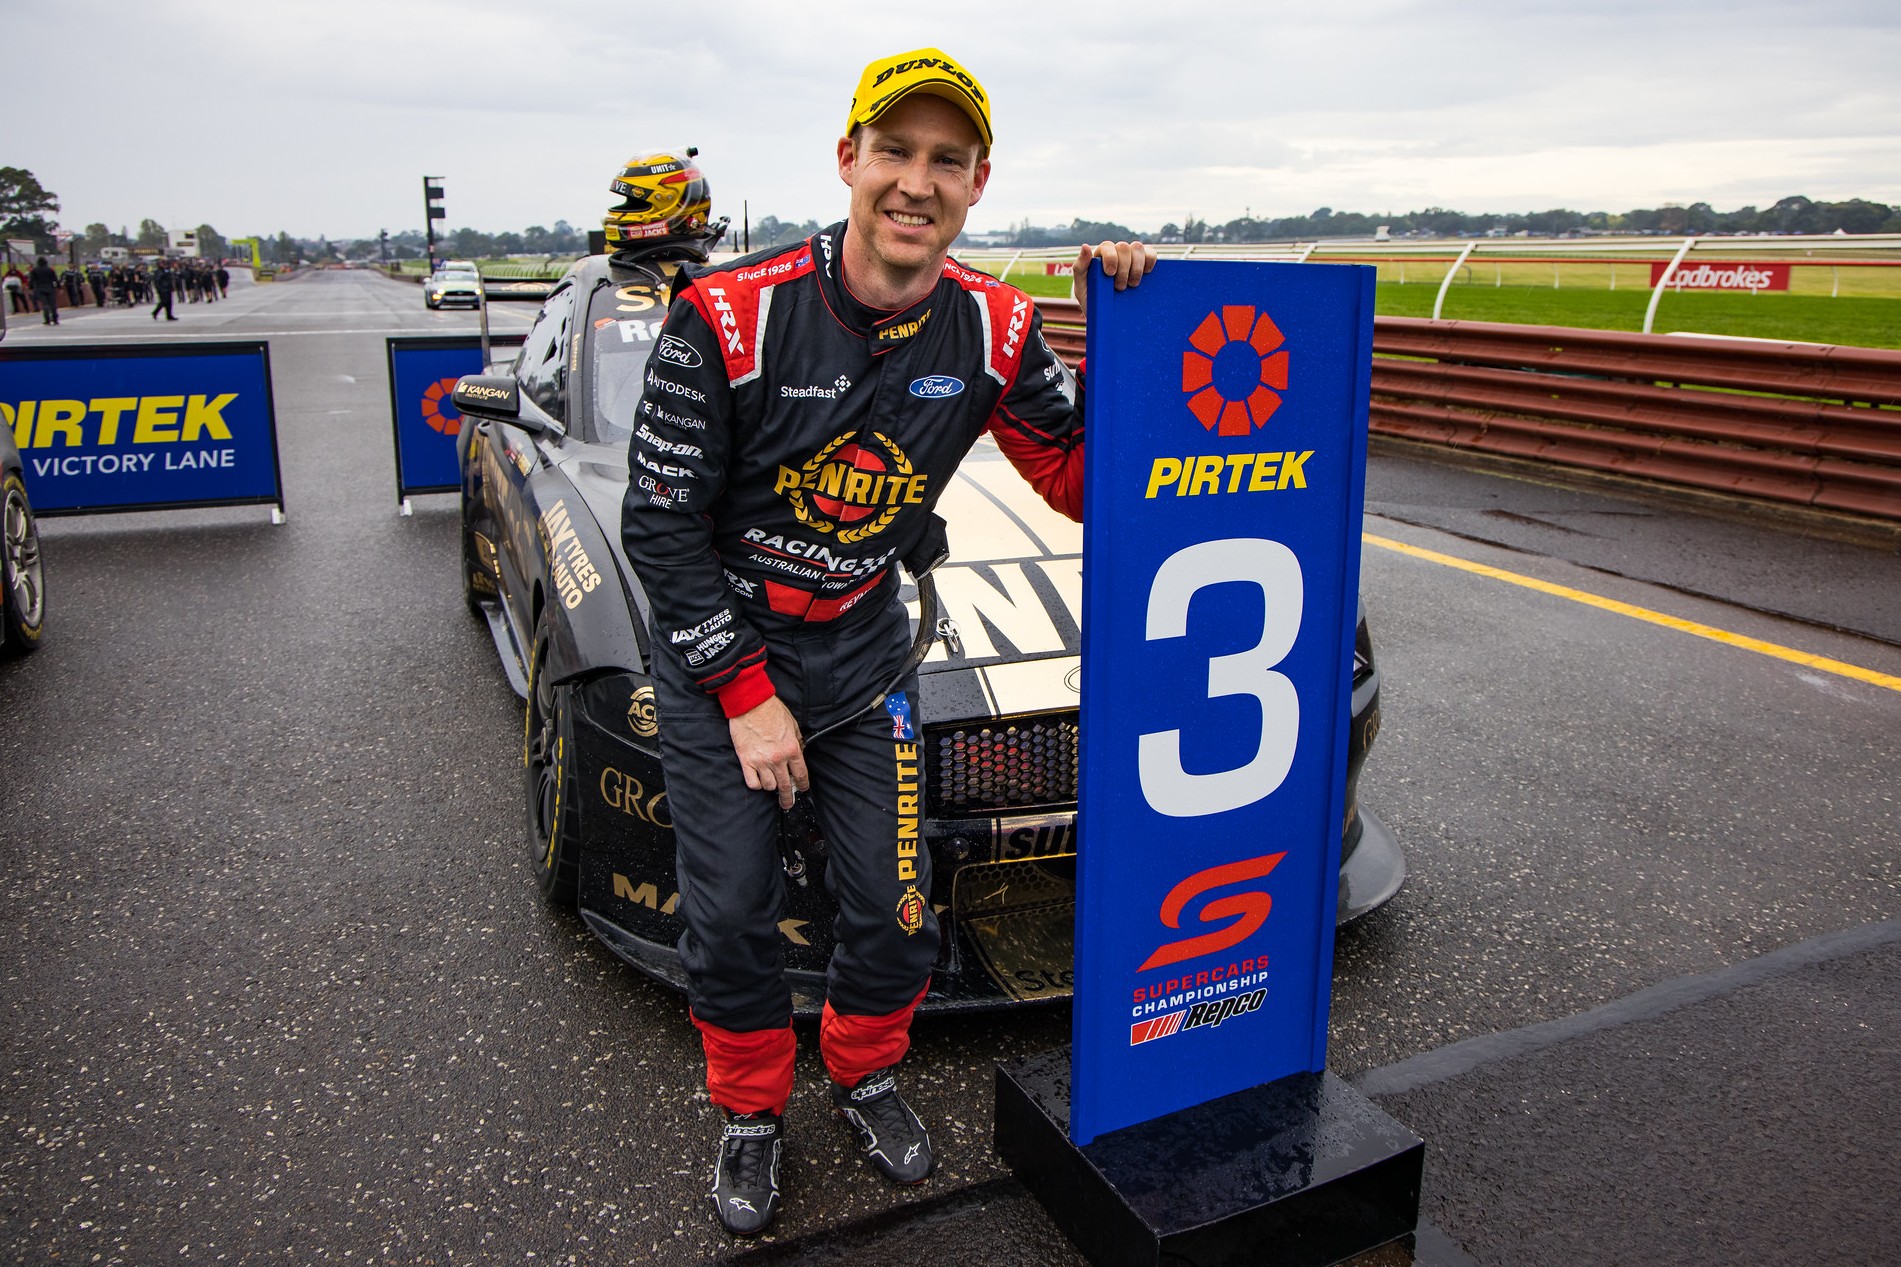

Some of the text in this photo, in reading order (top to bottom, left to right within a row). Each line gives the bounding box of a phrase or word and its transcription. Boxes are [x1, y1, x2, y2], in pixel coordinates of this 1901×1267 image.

[873, 58, 985, 103] DUNLOP
[651, 164, 669, 174] UNIT
[736, 261, 792, 282] SINCE 1926
[960, 272, 983, 283] 1926
[1666, 265, 1774, 288] Ladbrokes
[878, 308, 932, 340] PENRITE
[467, 385, 510, 400] KANGAN
[780, 383, 837, 400] Steadfast
[664, 412, 707, 430] KANGAN
[33, 449, 236, 477] VICTORY LANE
[637, 450, 697, 479] MACK
[1144, 450, 1316, 499] PIRTEK
[638, 474, 690, 503] GROVE
[773, 462, 928, 506] PENRITE
[649, 493, 673, 510] HIRE
[744, 527, 858, 572] RACING
[563, 536, 602, 594] TYRES
[748, 553, 822, 580] AUSTRALIAN
[553, 563, 584, 610] AUTO
[701, 608, 730, 630] TYRES
[695, 629, 728, 652] HUNGRY
[1138, 537, 1304, 818] 3
[894, 743, 919, 882] PENRITE
[906, 884, 919, 937] PENRITE
[1131, 971, 1269, 1017] CHAMPIONSHIP
[1132, 955, 1269, 1004] SUPERCARS
[1182, 987, 1268, 1032] Repco
